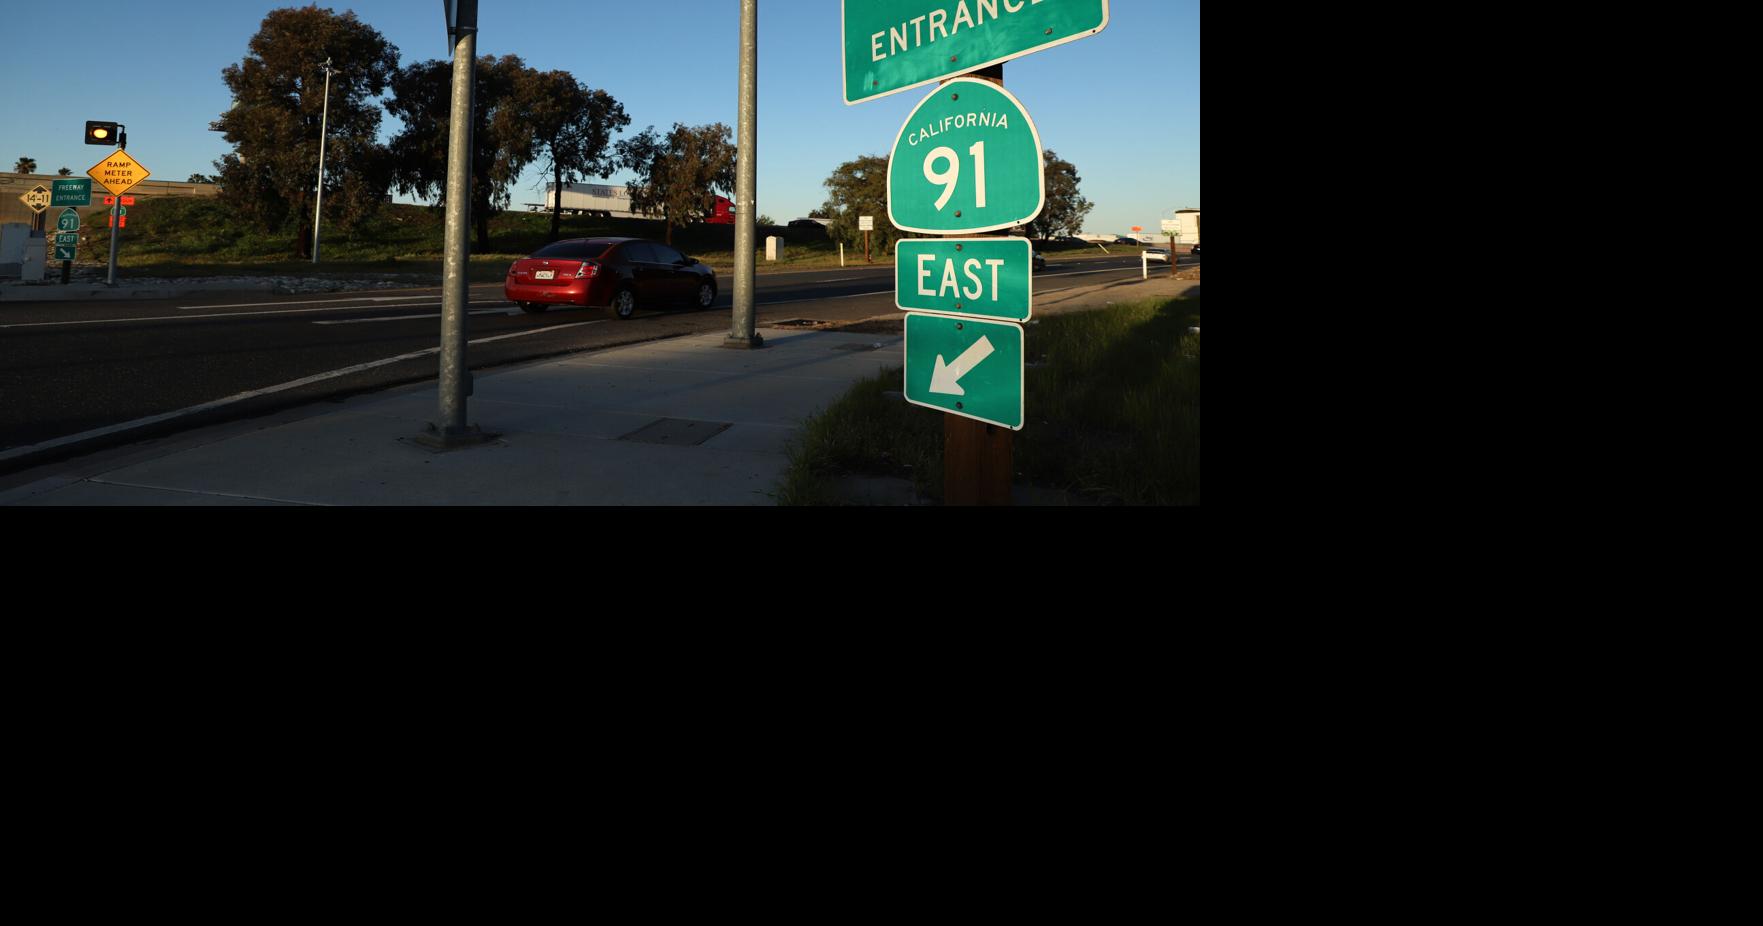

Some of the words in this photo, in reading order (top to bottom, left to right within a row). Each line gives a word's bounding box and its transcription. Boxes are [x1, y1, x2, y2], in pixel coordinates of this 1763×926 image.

[909, 112, 1009, 146] CALIFORNIA
[923, 140, 986, 211] 91
[61, 218, 74, 229] 91
[917, 254, 1005, 302] EAST
